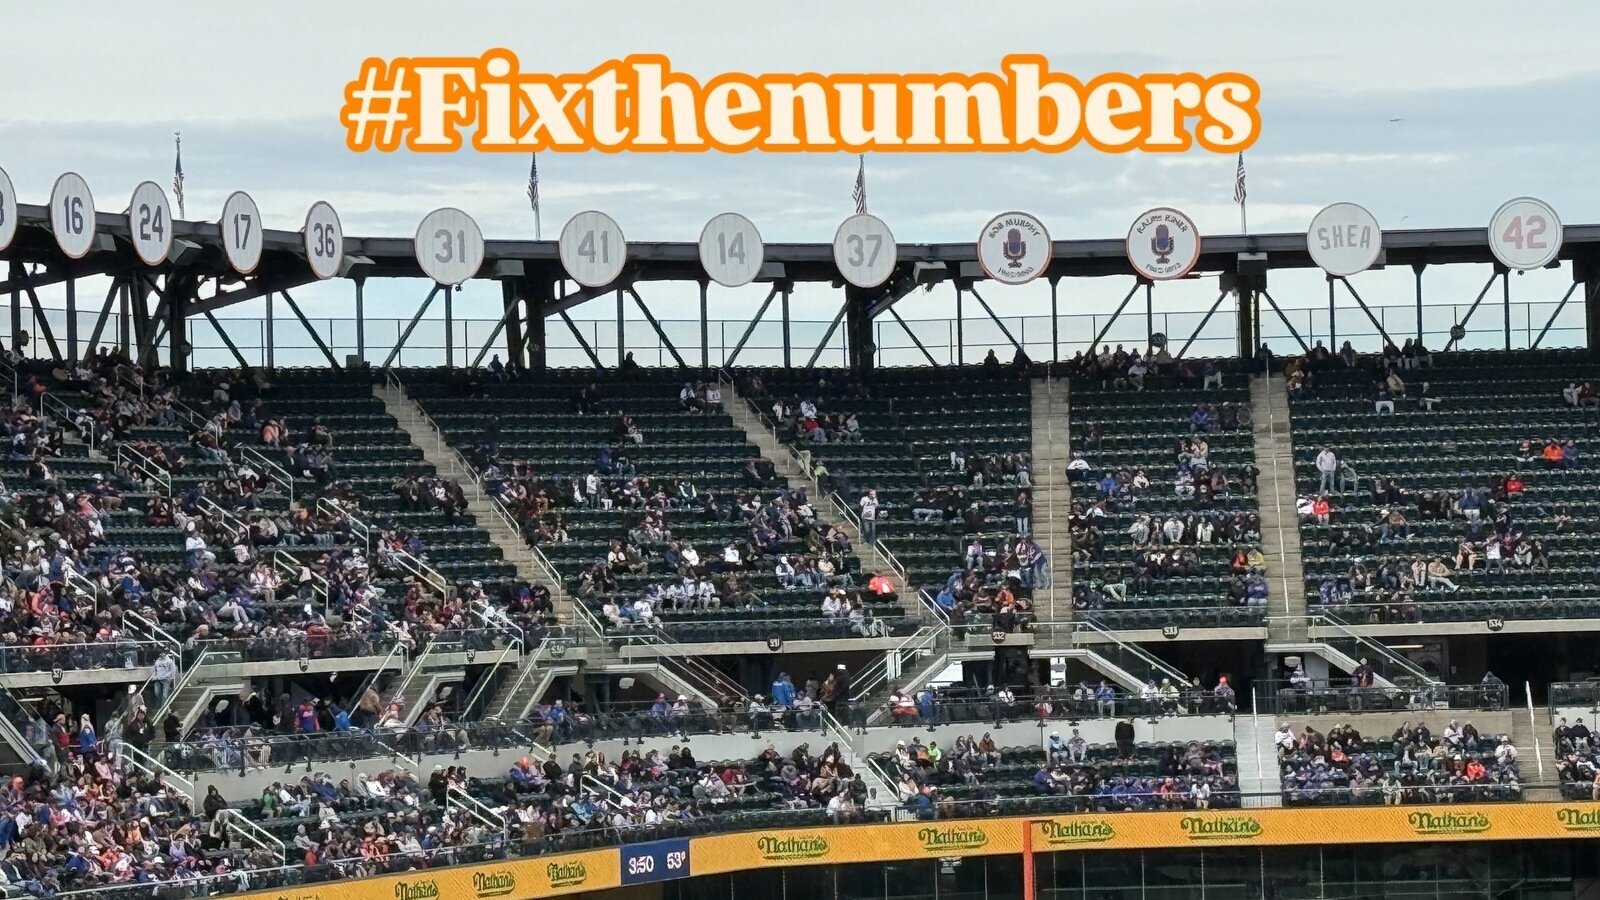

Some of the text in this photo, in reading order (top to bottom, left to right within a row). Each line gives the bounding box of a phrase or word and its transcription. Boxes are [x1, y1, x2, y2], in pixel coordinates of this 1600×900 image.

[64, 196, 84, 234] 16
[139, 203, 164, 242] 24
[233, 213, 251, 250] 17
[1502, 214, 1547, 250] 42
[313, 222, 336, 258] 36
[433, 229, 466, 264] 31
[577, 230, 610, 264] 41
[716, 231, 746, 265] 14
[846, 234, 883, 267] 37
[1317, 224, 1371, 250] SHEA
[1408, 811, 1488, 829] Nathan's
